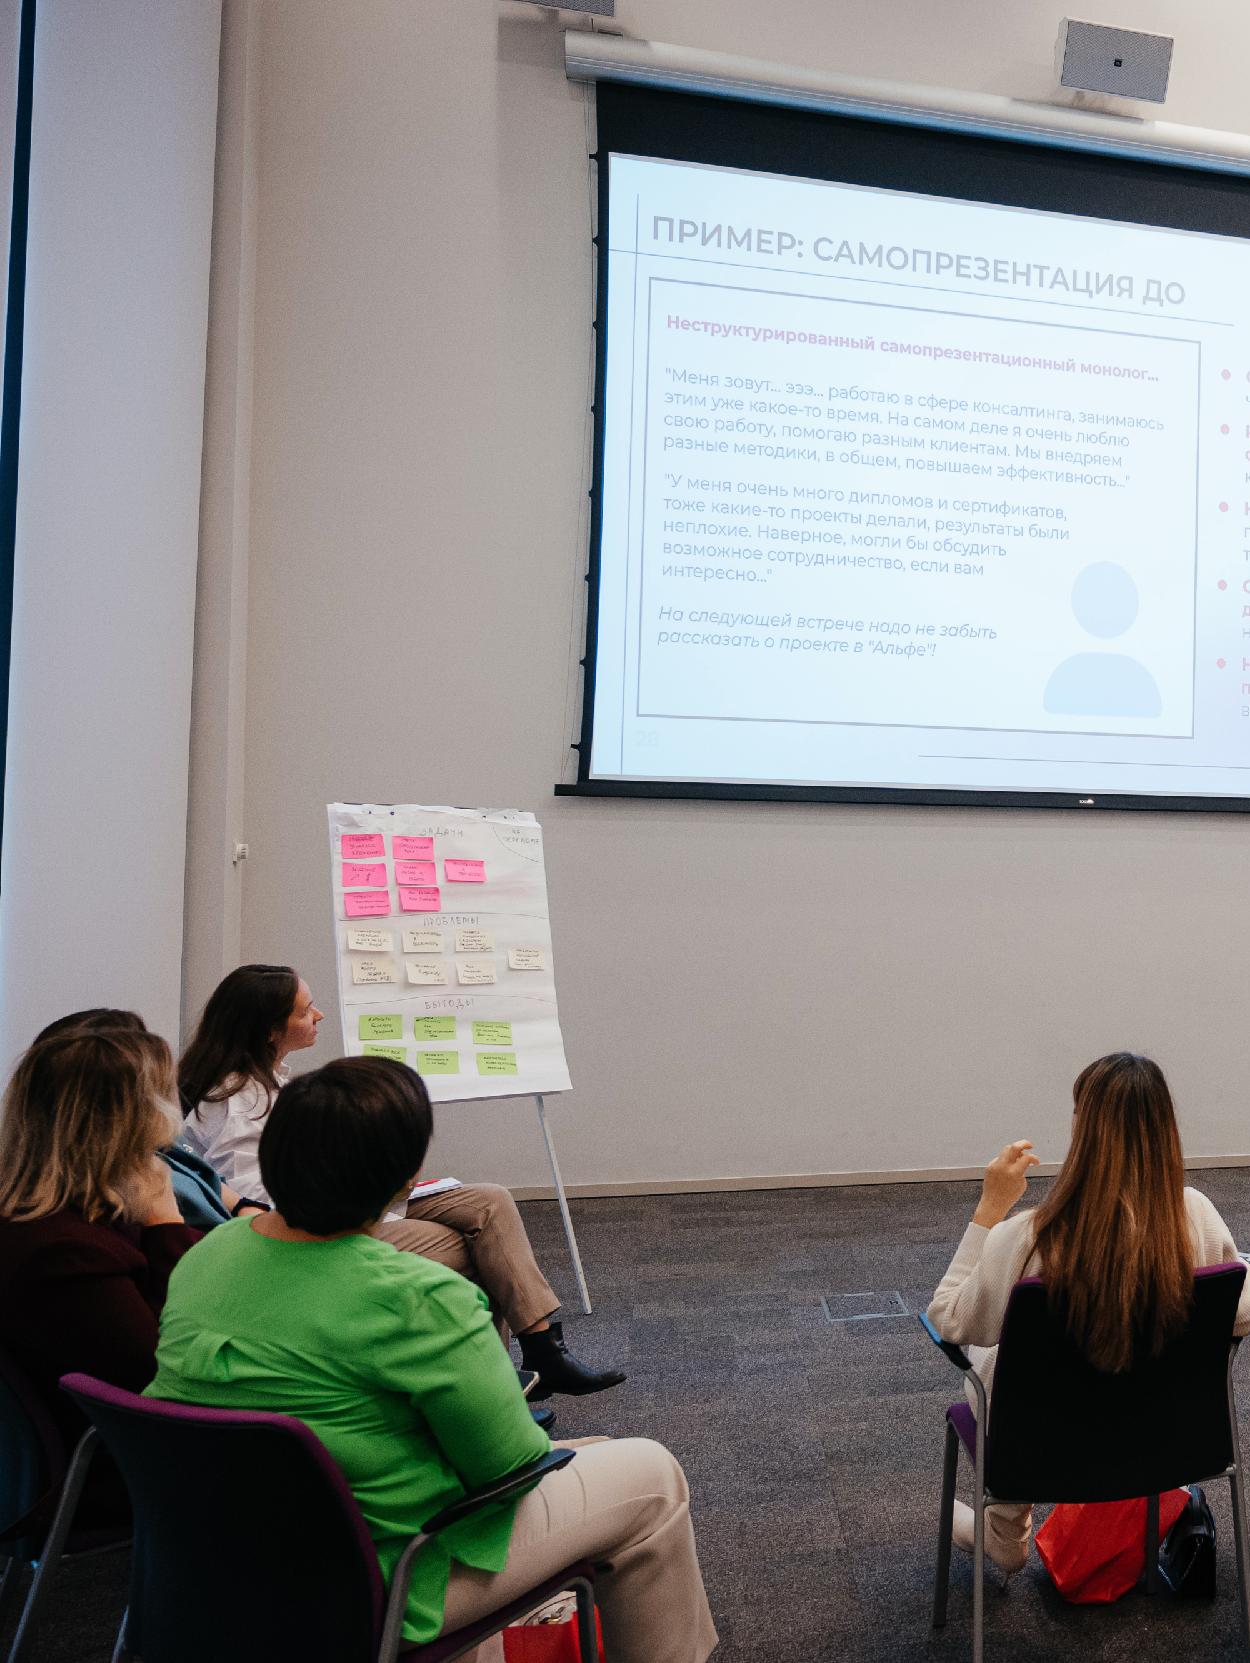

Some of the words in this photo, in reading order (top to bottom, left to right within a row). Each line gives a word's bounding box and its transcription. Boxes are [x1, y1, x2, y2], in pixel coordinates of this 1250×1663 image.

[653, 215, 804, 258] ПРИМЕР:
[813, 236, 1134, 299] САМОПРЕЗЕНТАЦИЯ
[1142, 278, 1186, 308] ДО
[667, 314, 875, 352] Неструктурированный
[880, 337, 1076, 372] самопрезентационный
[1080, 363, 1159, 382] монолог...
[663, 391, 707, 408] этим
[710, 396, 745, 412] уже
[749, 400, 822, 418] какое-то
[826, 407, 883, 425] время.
[888, 411, 909, 427] На
[913, 416, 965, 433] самом
[968, 421, 1009, 436] деле
[1012, 426, 1022, 438] я
[1024, 427, 1072, 442] очень
[1075, 431, 1130, 447] люблю
[665, 367, 720, 387] "Меня
[828, 384, 900, 405] работаю
[904, 394, 914, 407] в
[917, 393, 969, 413] сфере
[973, 400, 1075, 424] консалтинга,
[1078, 411, 1164, 431] занимаюсь
[663, 414, 710, 430] свою
[714, 417, 777, 438] работу,
[781, 425, 857, 443] помогаю
[861, 432, 925, 449] разным
[1015, 443, 1041, 460] Мы
[1045, 449, 1122, 468] внедряем
[663, 436, 729, 453] разные
[733, 442, 821, 463] методики,
[825, 450, 835, 462] в
[839, 449, 901, 471] общем,
[904, 458, 992, 476] повышаем
[663, 498, 706, 513] тоже
[711, 501, 786, 519] какие-то
[790, 508, 862, 525] проекты
[864, 513, 931, 533] делали,
[935, 519, 1024, 537] результаты
[1028, 523, 1070, 540] были
[687, 478, 732, 493] меня
[737, 481, 789, 497] очень
[793, 486, 845, 502] много
[848, 491, 934, 509] дипломов
[938, 498, 948, 510] и
[952, 499, 1067, 522] сертификатов,
[663, 542, 764, 560] возможное
[767, 550, 907, 572] сотрудничество,
[910, 559, 949, 574] если
[954, 563, 984, 576] вам
[757, 524, 847, 547] Наверное,
[851, 534, 902, 549] могли
[905, 535, 928, 551] бы
[932, 537, 1007, 557] обсудить
[657, 631, 760, 648] рассказать
[763, 636, 775, 648] о
[779, 638, 850, 653] проекте
[853, 641, 864, 653] в
[658, 605, 684, 622] На
[688, 610, 792, 629] следующей
[796, 616, 865, 633] встрече
[868, 621, 911, 636] надо
[915, 623, 936, 636] не
[939, 623, 997, 639] забыть
[423, 915, 480, 926] ПРОБЛЕМЫ
[424, 999, 474, 1010] ВЫГОДЫ
